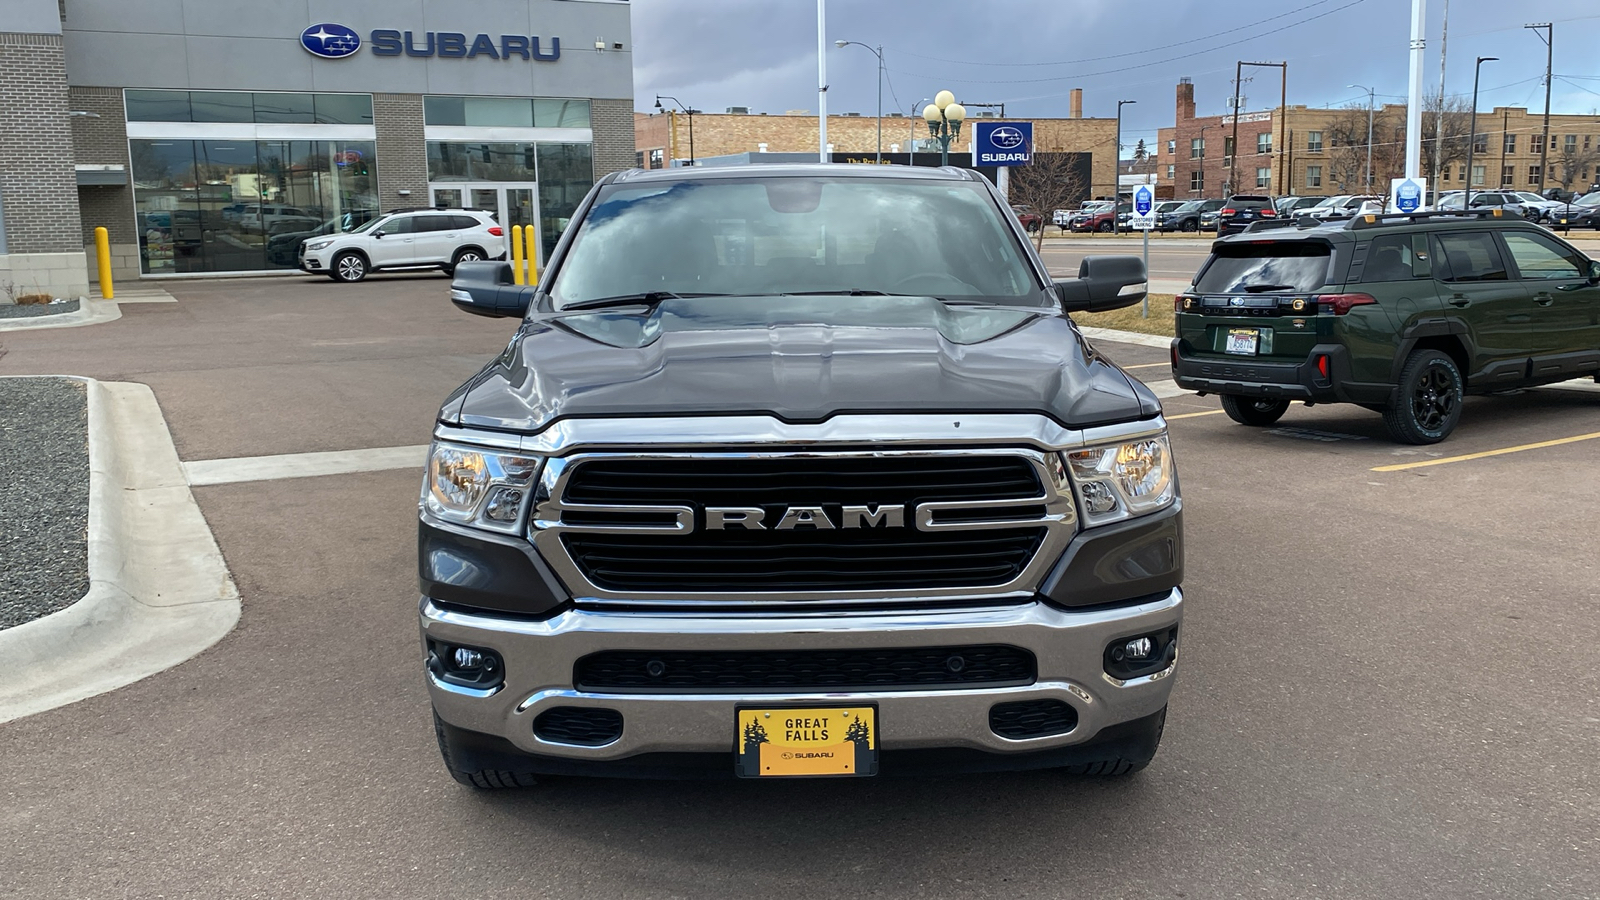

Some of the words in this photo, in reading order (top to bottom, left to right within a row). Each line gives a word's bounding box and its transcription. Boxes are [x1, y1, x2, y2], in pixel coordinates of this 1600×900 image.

[371, 29, 561, 61] SUBARU
[981, 153, 1030, 162] SUBARU
[705, 504, 905, 530] RAM
[785, 718, 829, 729] GREAT
[785, 730, 829, 742] FALLS
